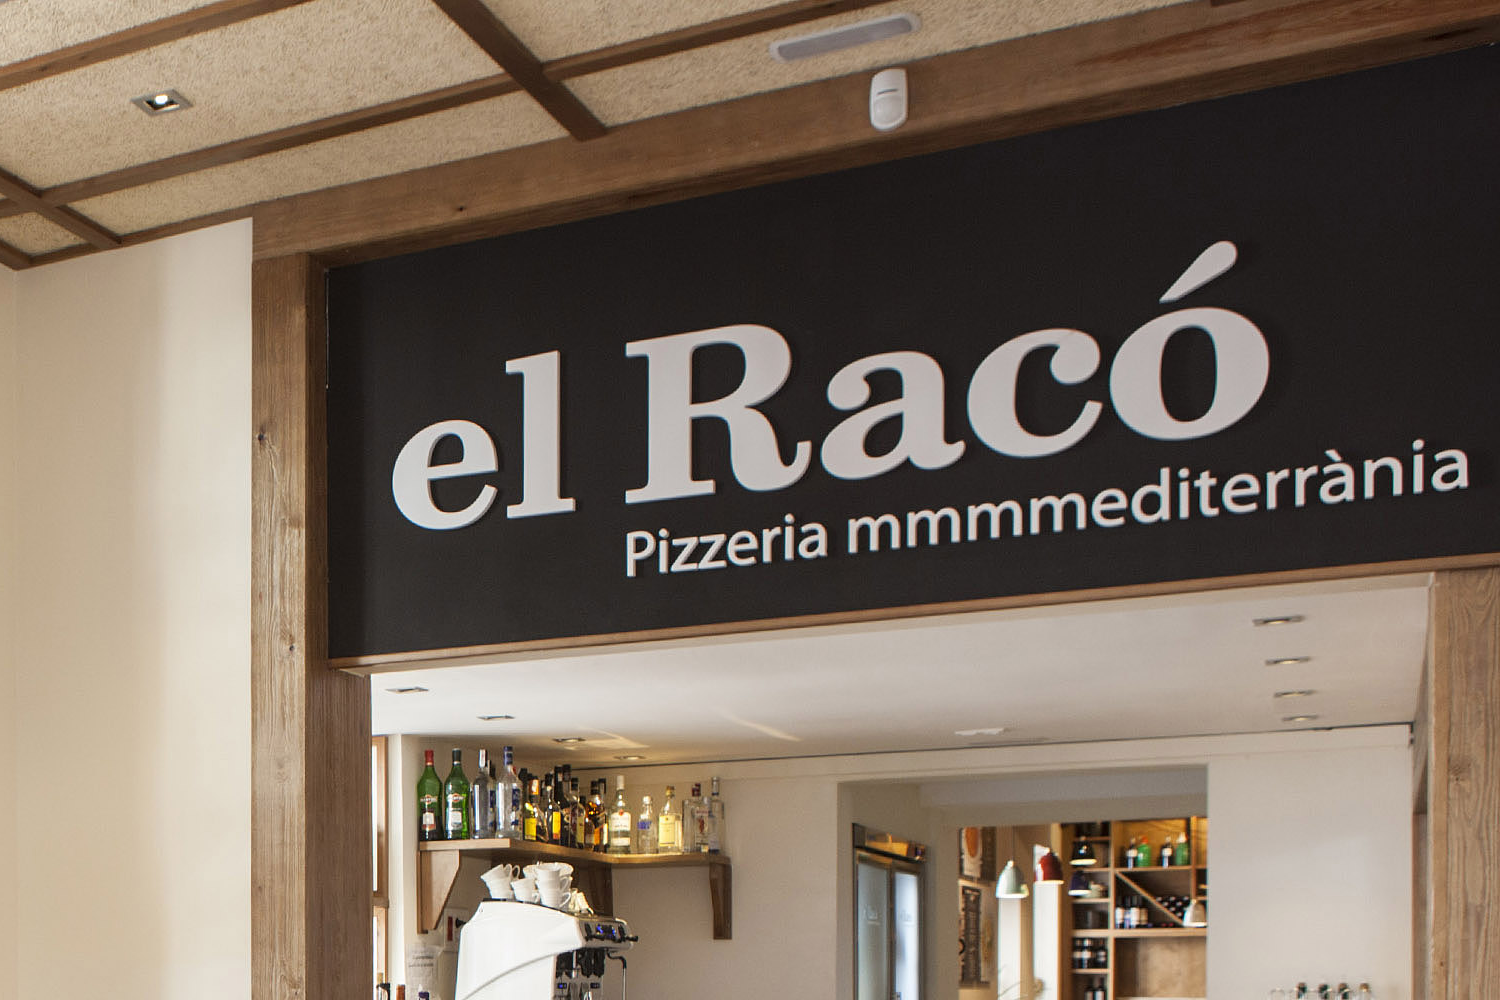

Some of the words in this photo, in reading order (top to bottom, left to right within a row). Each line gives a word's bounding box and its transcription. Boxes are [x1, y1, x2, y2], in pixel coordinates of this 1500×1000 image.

[391, 350, 577, 530] el
[625, 240, 1271, 505] Racó
[626, 513, 829, 578] Pizzeria
[847, 439, 1470, 554] mmmmediterrània
